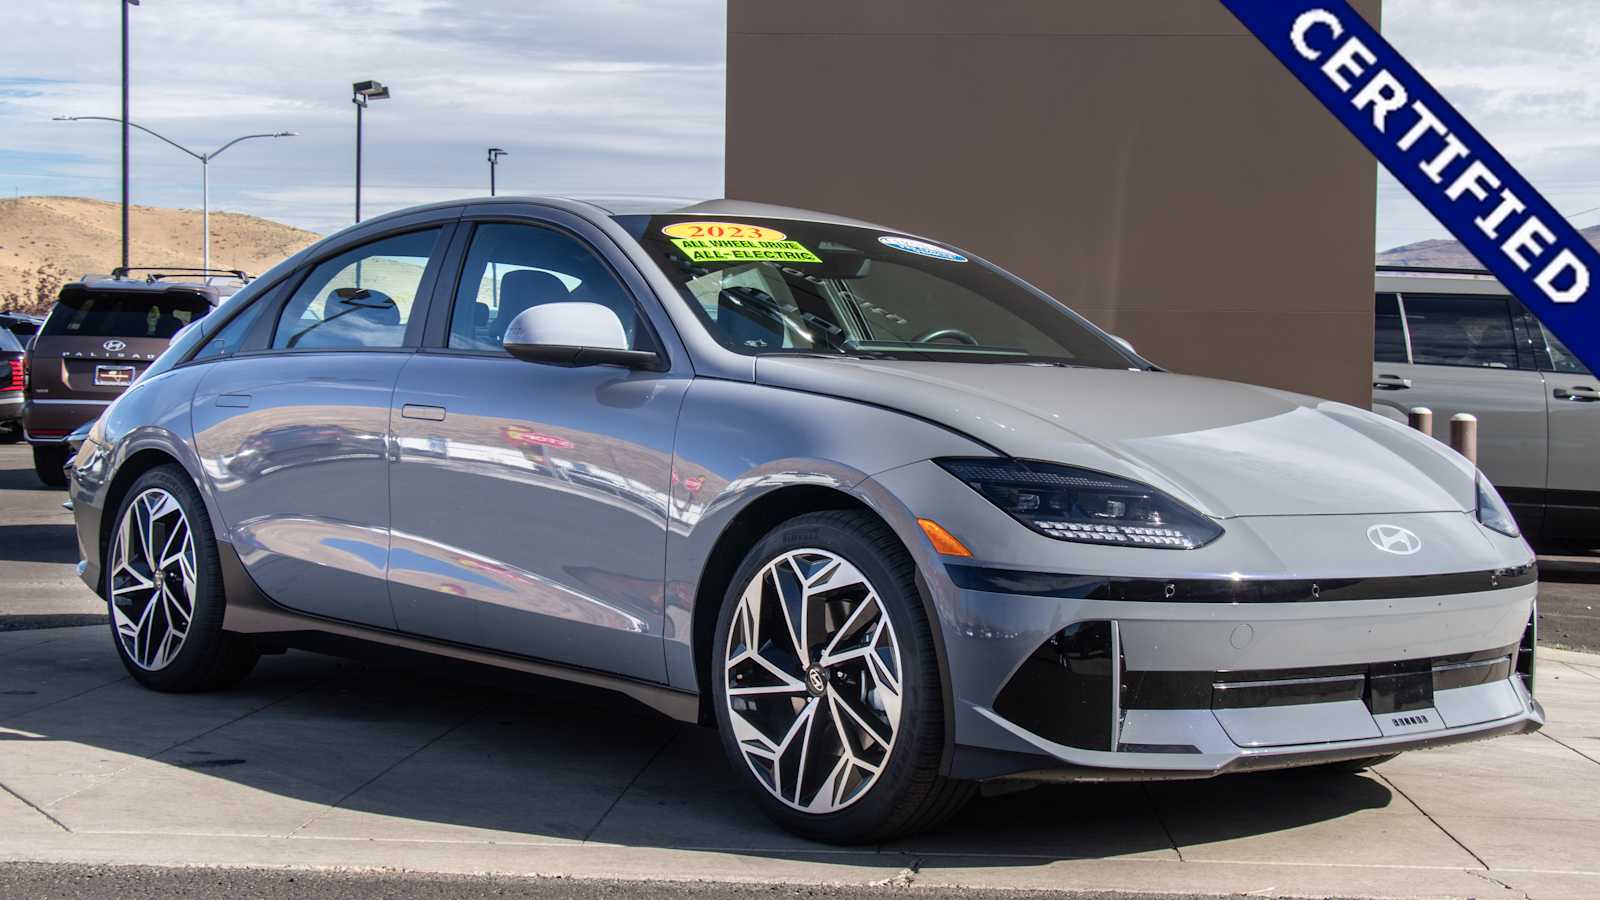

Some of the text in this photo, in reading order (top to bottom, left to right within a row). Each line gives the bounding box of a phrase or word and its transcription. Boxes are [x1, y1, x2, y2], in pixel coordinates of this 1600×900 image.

[688, 226, 763, 238] 2023
[683, 240, 798, 249] ALL WHEEL DRIVE
[694, 250, 812, 260] ALL-ELECTRIC
